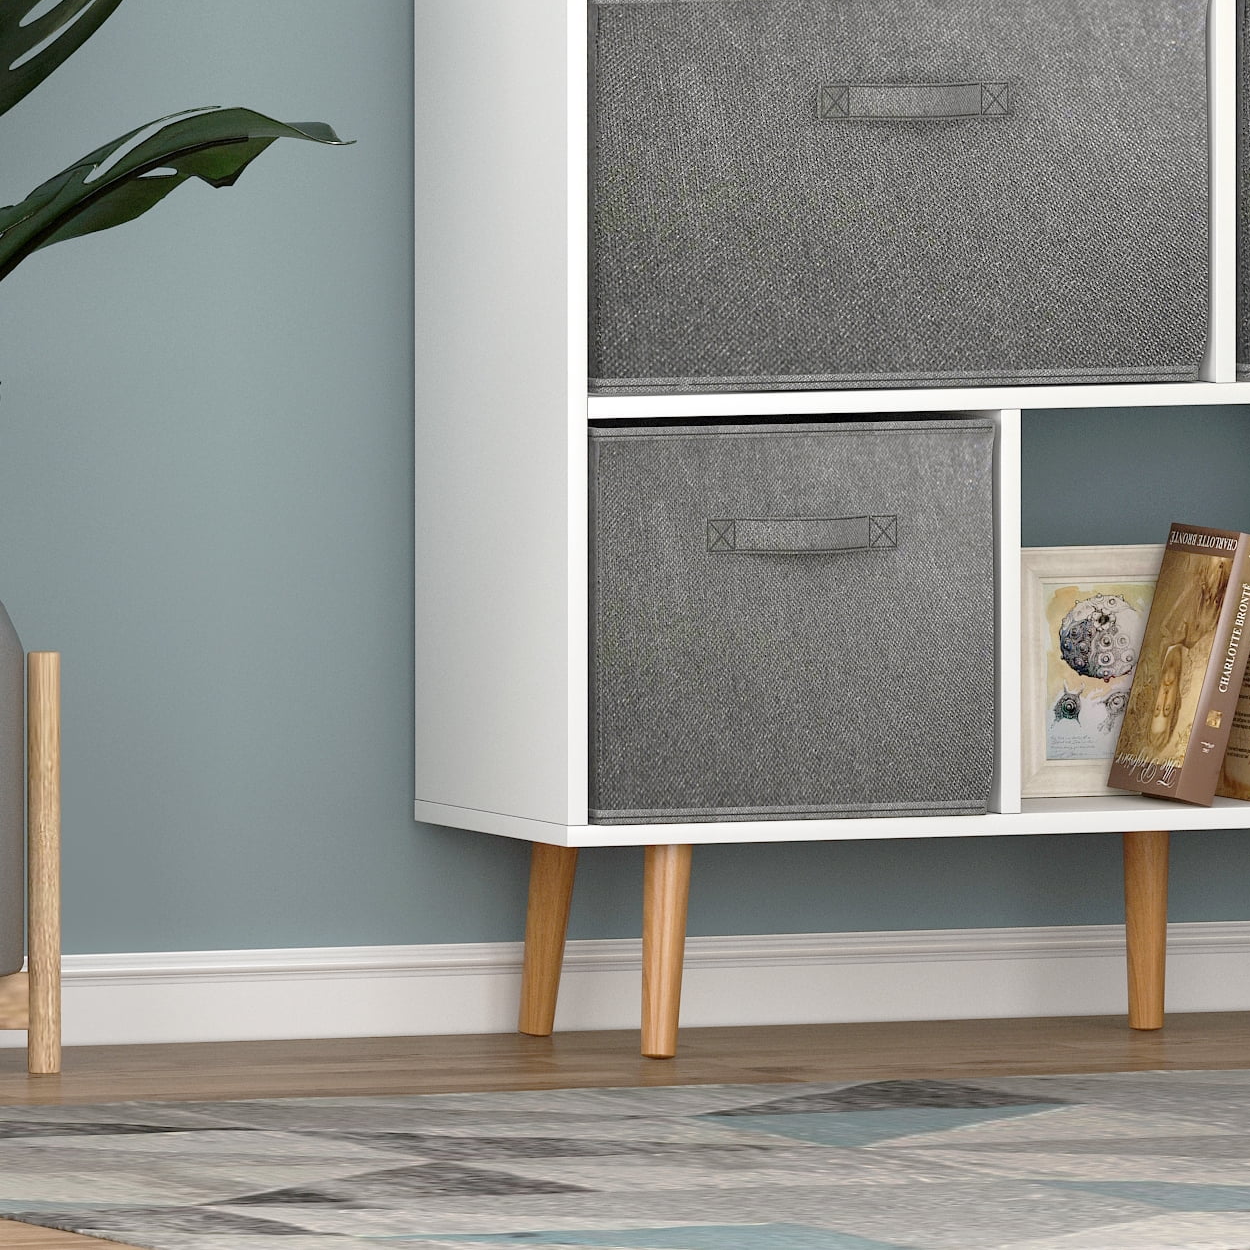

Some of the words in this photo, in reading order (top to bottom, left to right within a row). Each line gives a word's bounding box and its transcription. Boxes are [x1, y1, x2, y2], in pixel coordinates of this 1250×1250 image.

[1199, 534, 1239, 551] CHARLOTTE
[1219, 627, 1243, 692] CHARLOTTE
[1116, 748, 1159, 784] Professor
[1156, 758, 1177, 789] The
